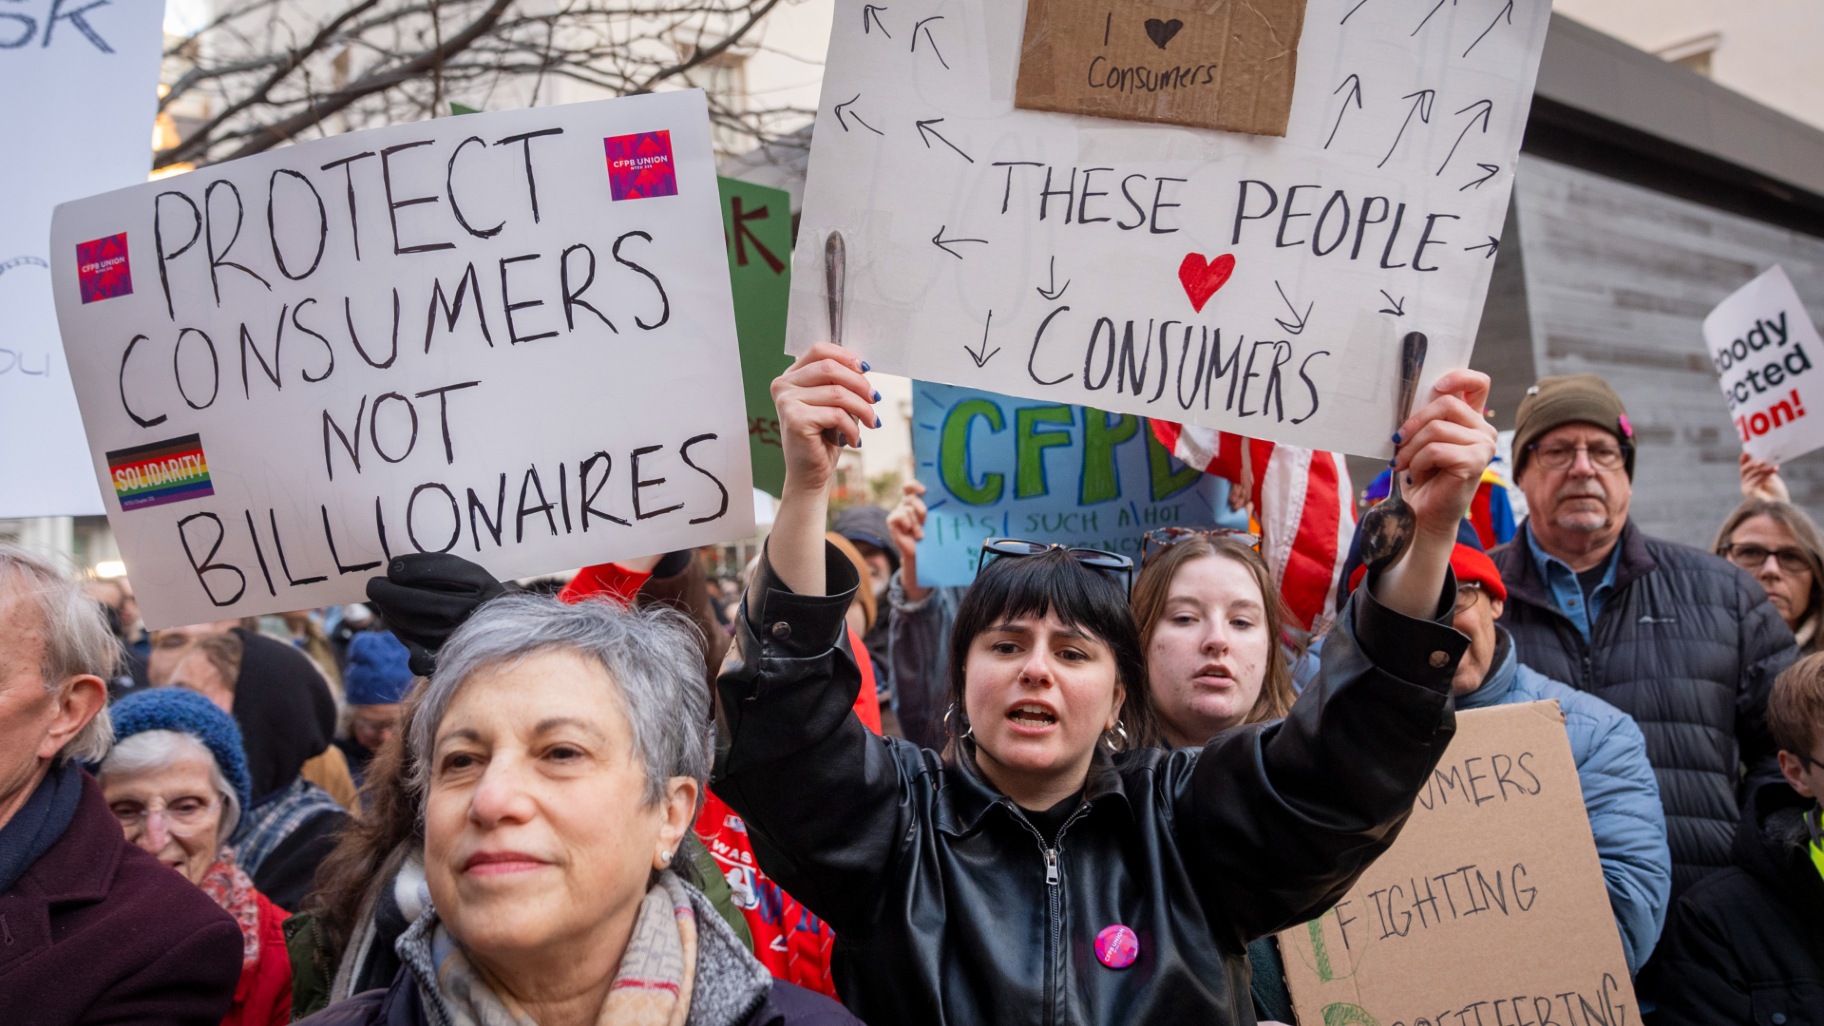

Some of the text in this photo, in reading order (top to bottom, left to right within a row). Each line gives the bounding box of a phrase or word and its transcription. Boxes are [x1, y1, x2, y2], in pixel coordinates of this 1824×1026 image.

[1104, 12, 1112, 46] I
[1088, 56, 1217, 94] Consumers
[613, 155, 668, 168] CFPB UNION
[155, 127, 563, 321] PROTECT
[992, 161, 1460, 272] THESE PEOPLE
[100, 256, 125, 268] UNION
[120, 231, 669, 428] CONSUMERS
[1028, 306, 1330, 424] CONSUMERS
[323, 381, 482, 481] NOT
[115, 453, 203, 492] SOLIDARITY
[177, 433, 729, 607] BILLIONAIRES
[1025, 511, 1099, 533] SUCH
[1144, 503, 1184, 523] HOT
[1112, 927, 1126, 947] UNION
